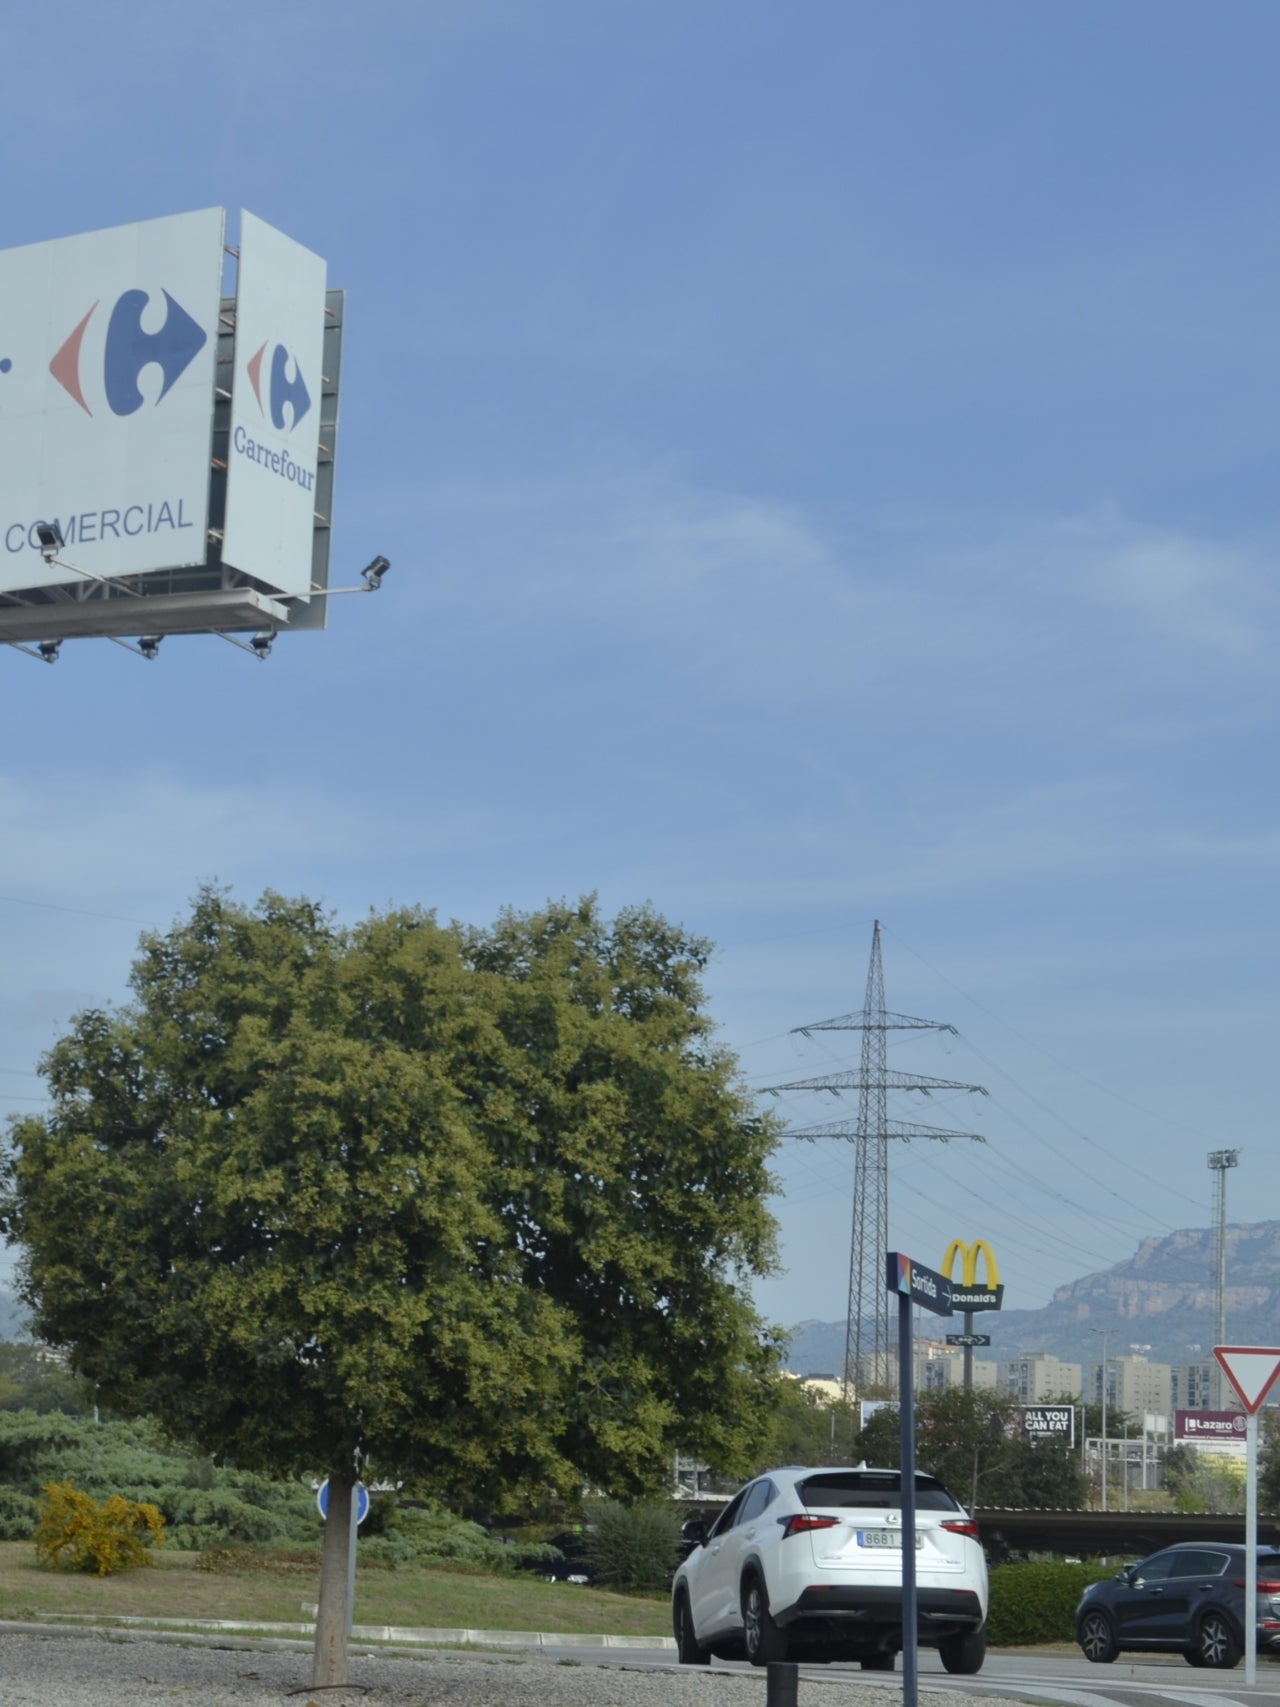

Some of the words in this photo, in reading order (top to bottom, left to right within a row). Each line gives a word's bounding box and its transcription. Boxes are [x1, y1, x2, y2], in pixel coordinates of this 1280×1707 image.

[234, 425, 315, 491] Carrefour
[4, 498, 194, 553] COMERCIAL
[911, 1268, 937, 1299] Sortida
[952, 1293, 997, 1304] Donald's
[1025, 1411, 1044, 1421] ALL
[1045, 1411, 1068, 1421] YOU
[1024, 1421, 1048, 1431] CAN
[1049, 1421, 1069, 1431] EAT
[1196, 1418, 1233, 1430] Lazaro
[865, 1533, 896, 1545] 8681
